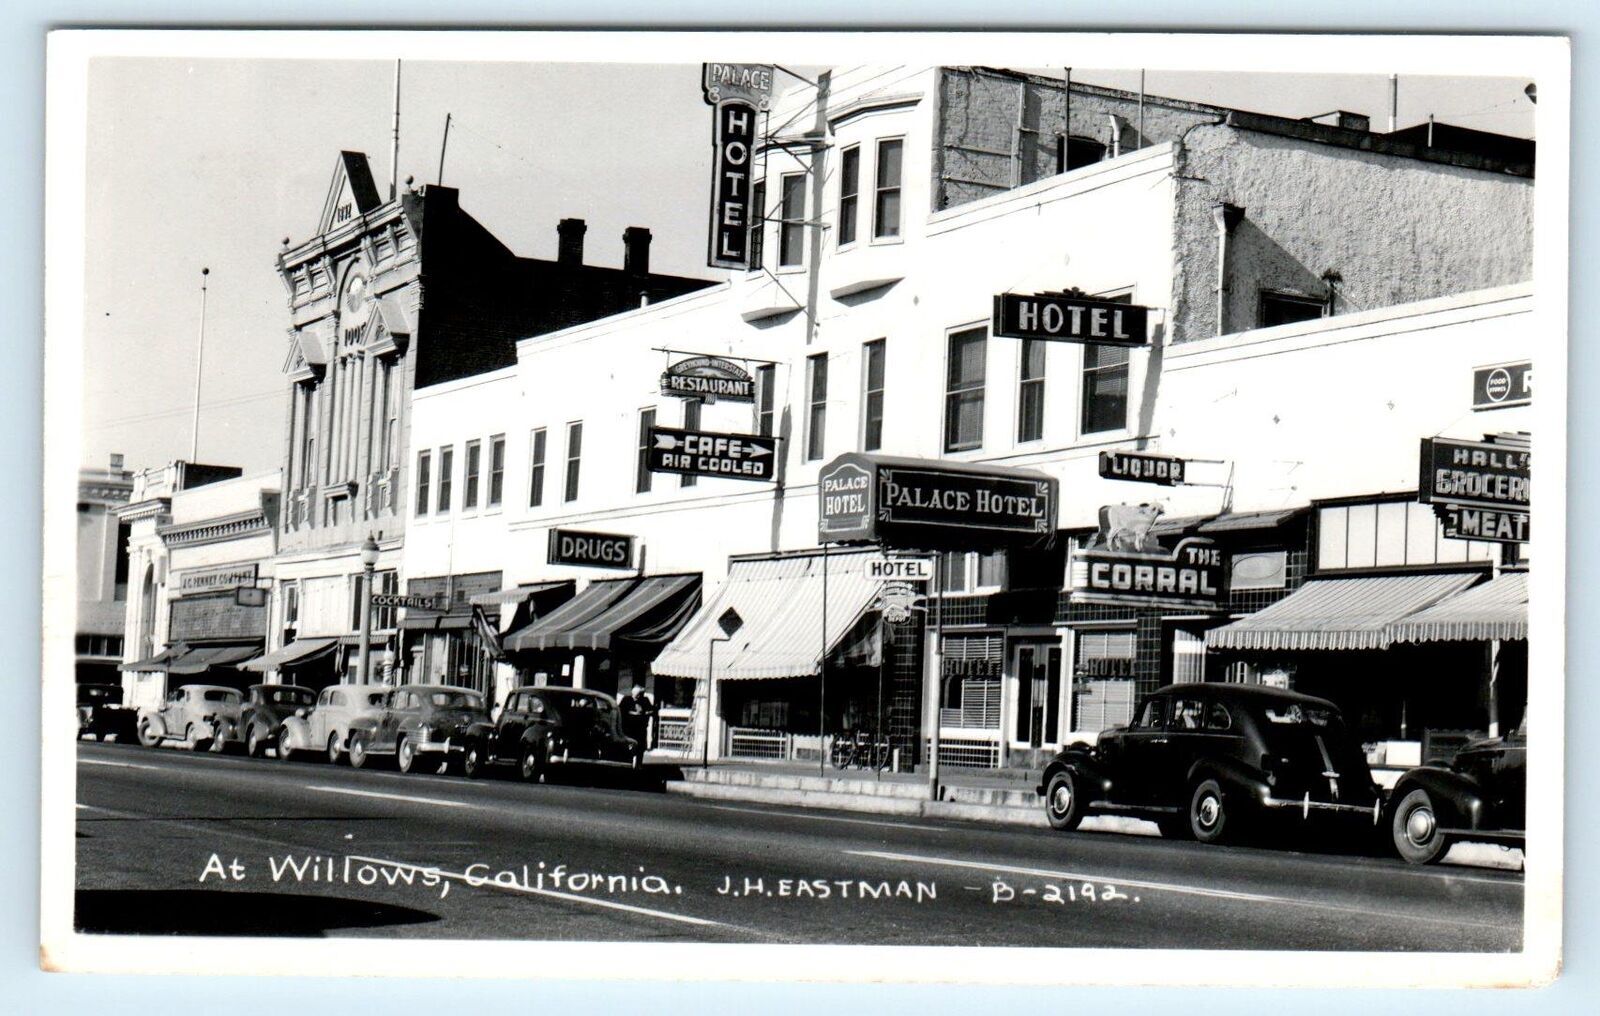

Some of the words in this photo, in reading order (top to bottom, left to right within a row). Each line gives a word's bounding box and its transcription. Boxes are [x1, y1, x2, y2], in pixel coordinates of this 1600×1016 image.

[712, 63, 769, 90] PALACE
[723, 110, 748, 256] HOTEL
[1019, 301, 1130, 339] HOTEL
[671, 376, 750, 395] RESTAURANT
[684, 435, 742, 458] CAFE
[662, 453, 691, 468] AIR
[698, 457, 764, 475] COOLED
[1112, 456, 1182, 479] LIQUOR
[825, 476, 868, 492] PALACE
[826, 493, 866, 515] HOTEL
[885, 482, 970, 511] PALACE
[976, 489, 1044, 517] HOTEL
[561, 536, 626, 562] DRUGS
[1186, 547, 1221, 567] THE
[872, 562, 928, 576] HOTEL
[1091, 562, 1217, 596] CORRAL
[372, 595, 432, 608] COCKTAILS
